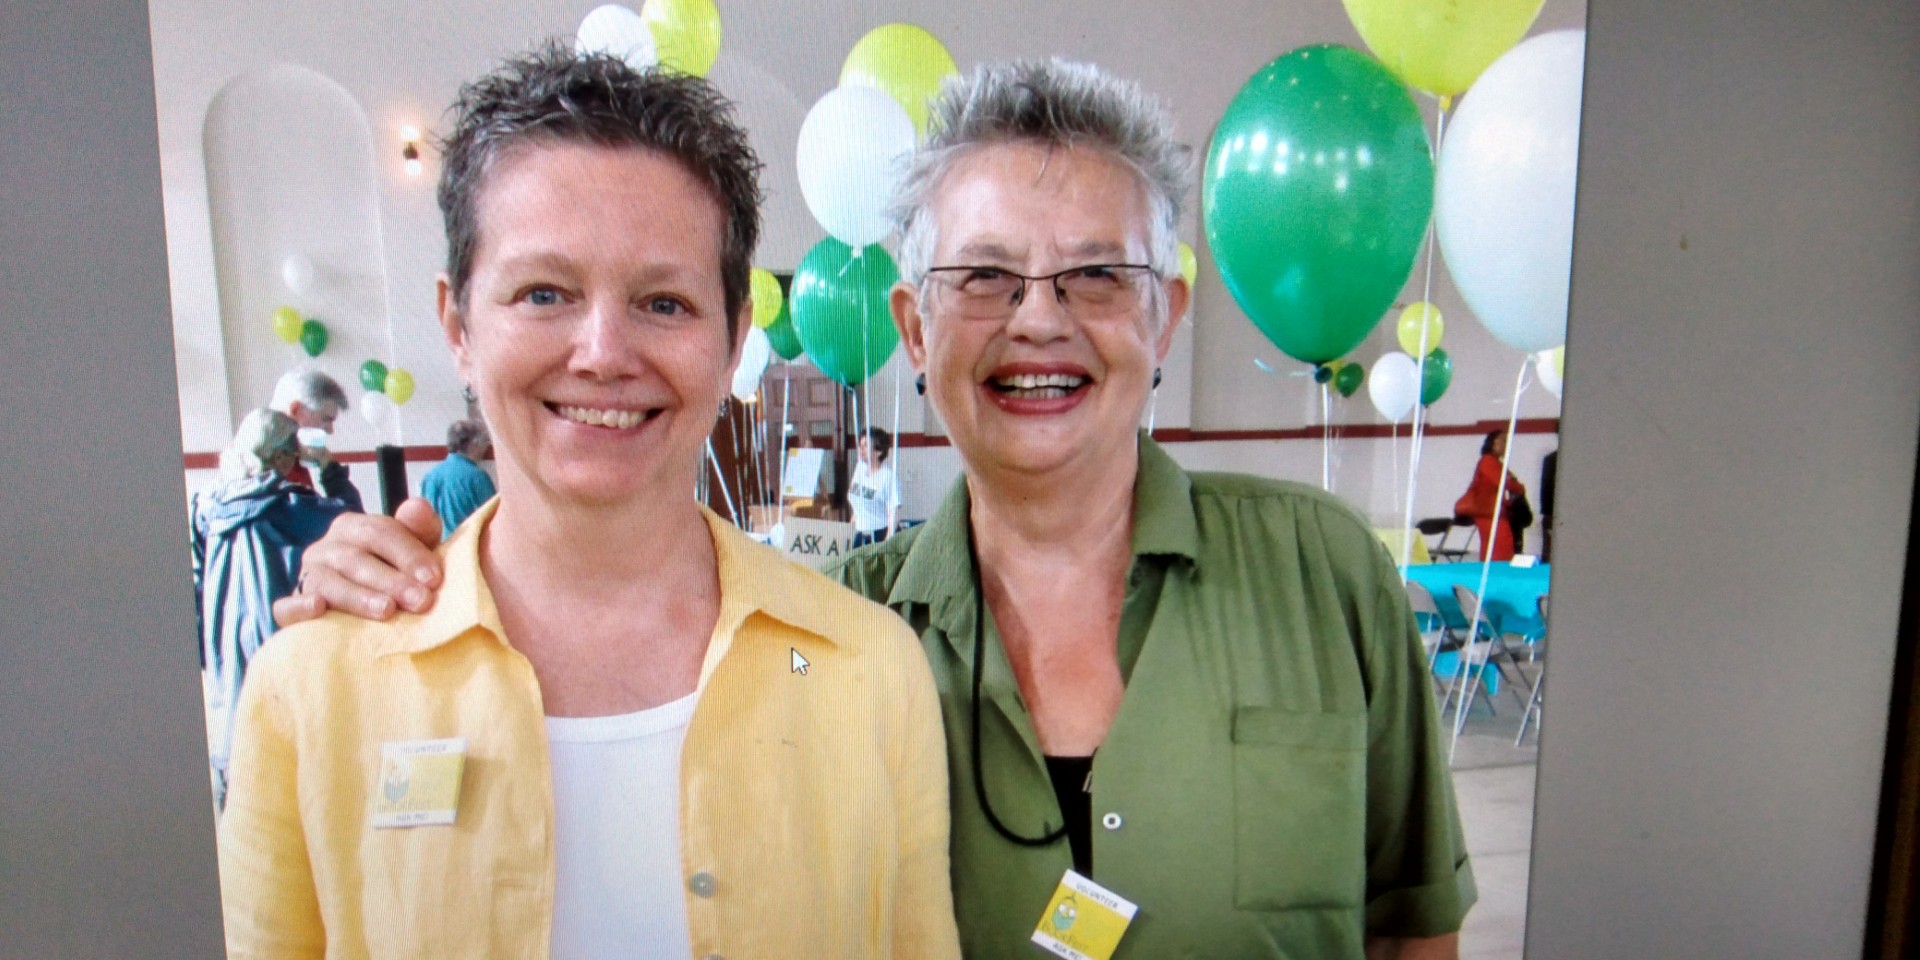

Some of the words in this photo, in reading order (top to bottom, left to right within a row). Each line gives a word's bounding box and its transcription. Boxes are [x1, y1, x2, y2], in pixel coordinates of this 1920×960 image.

[790, 534, 822, 555] ASK
[826, 540, 839, 556] A
[1075, 882, 1119, 909] VOLUNTEER
